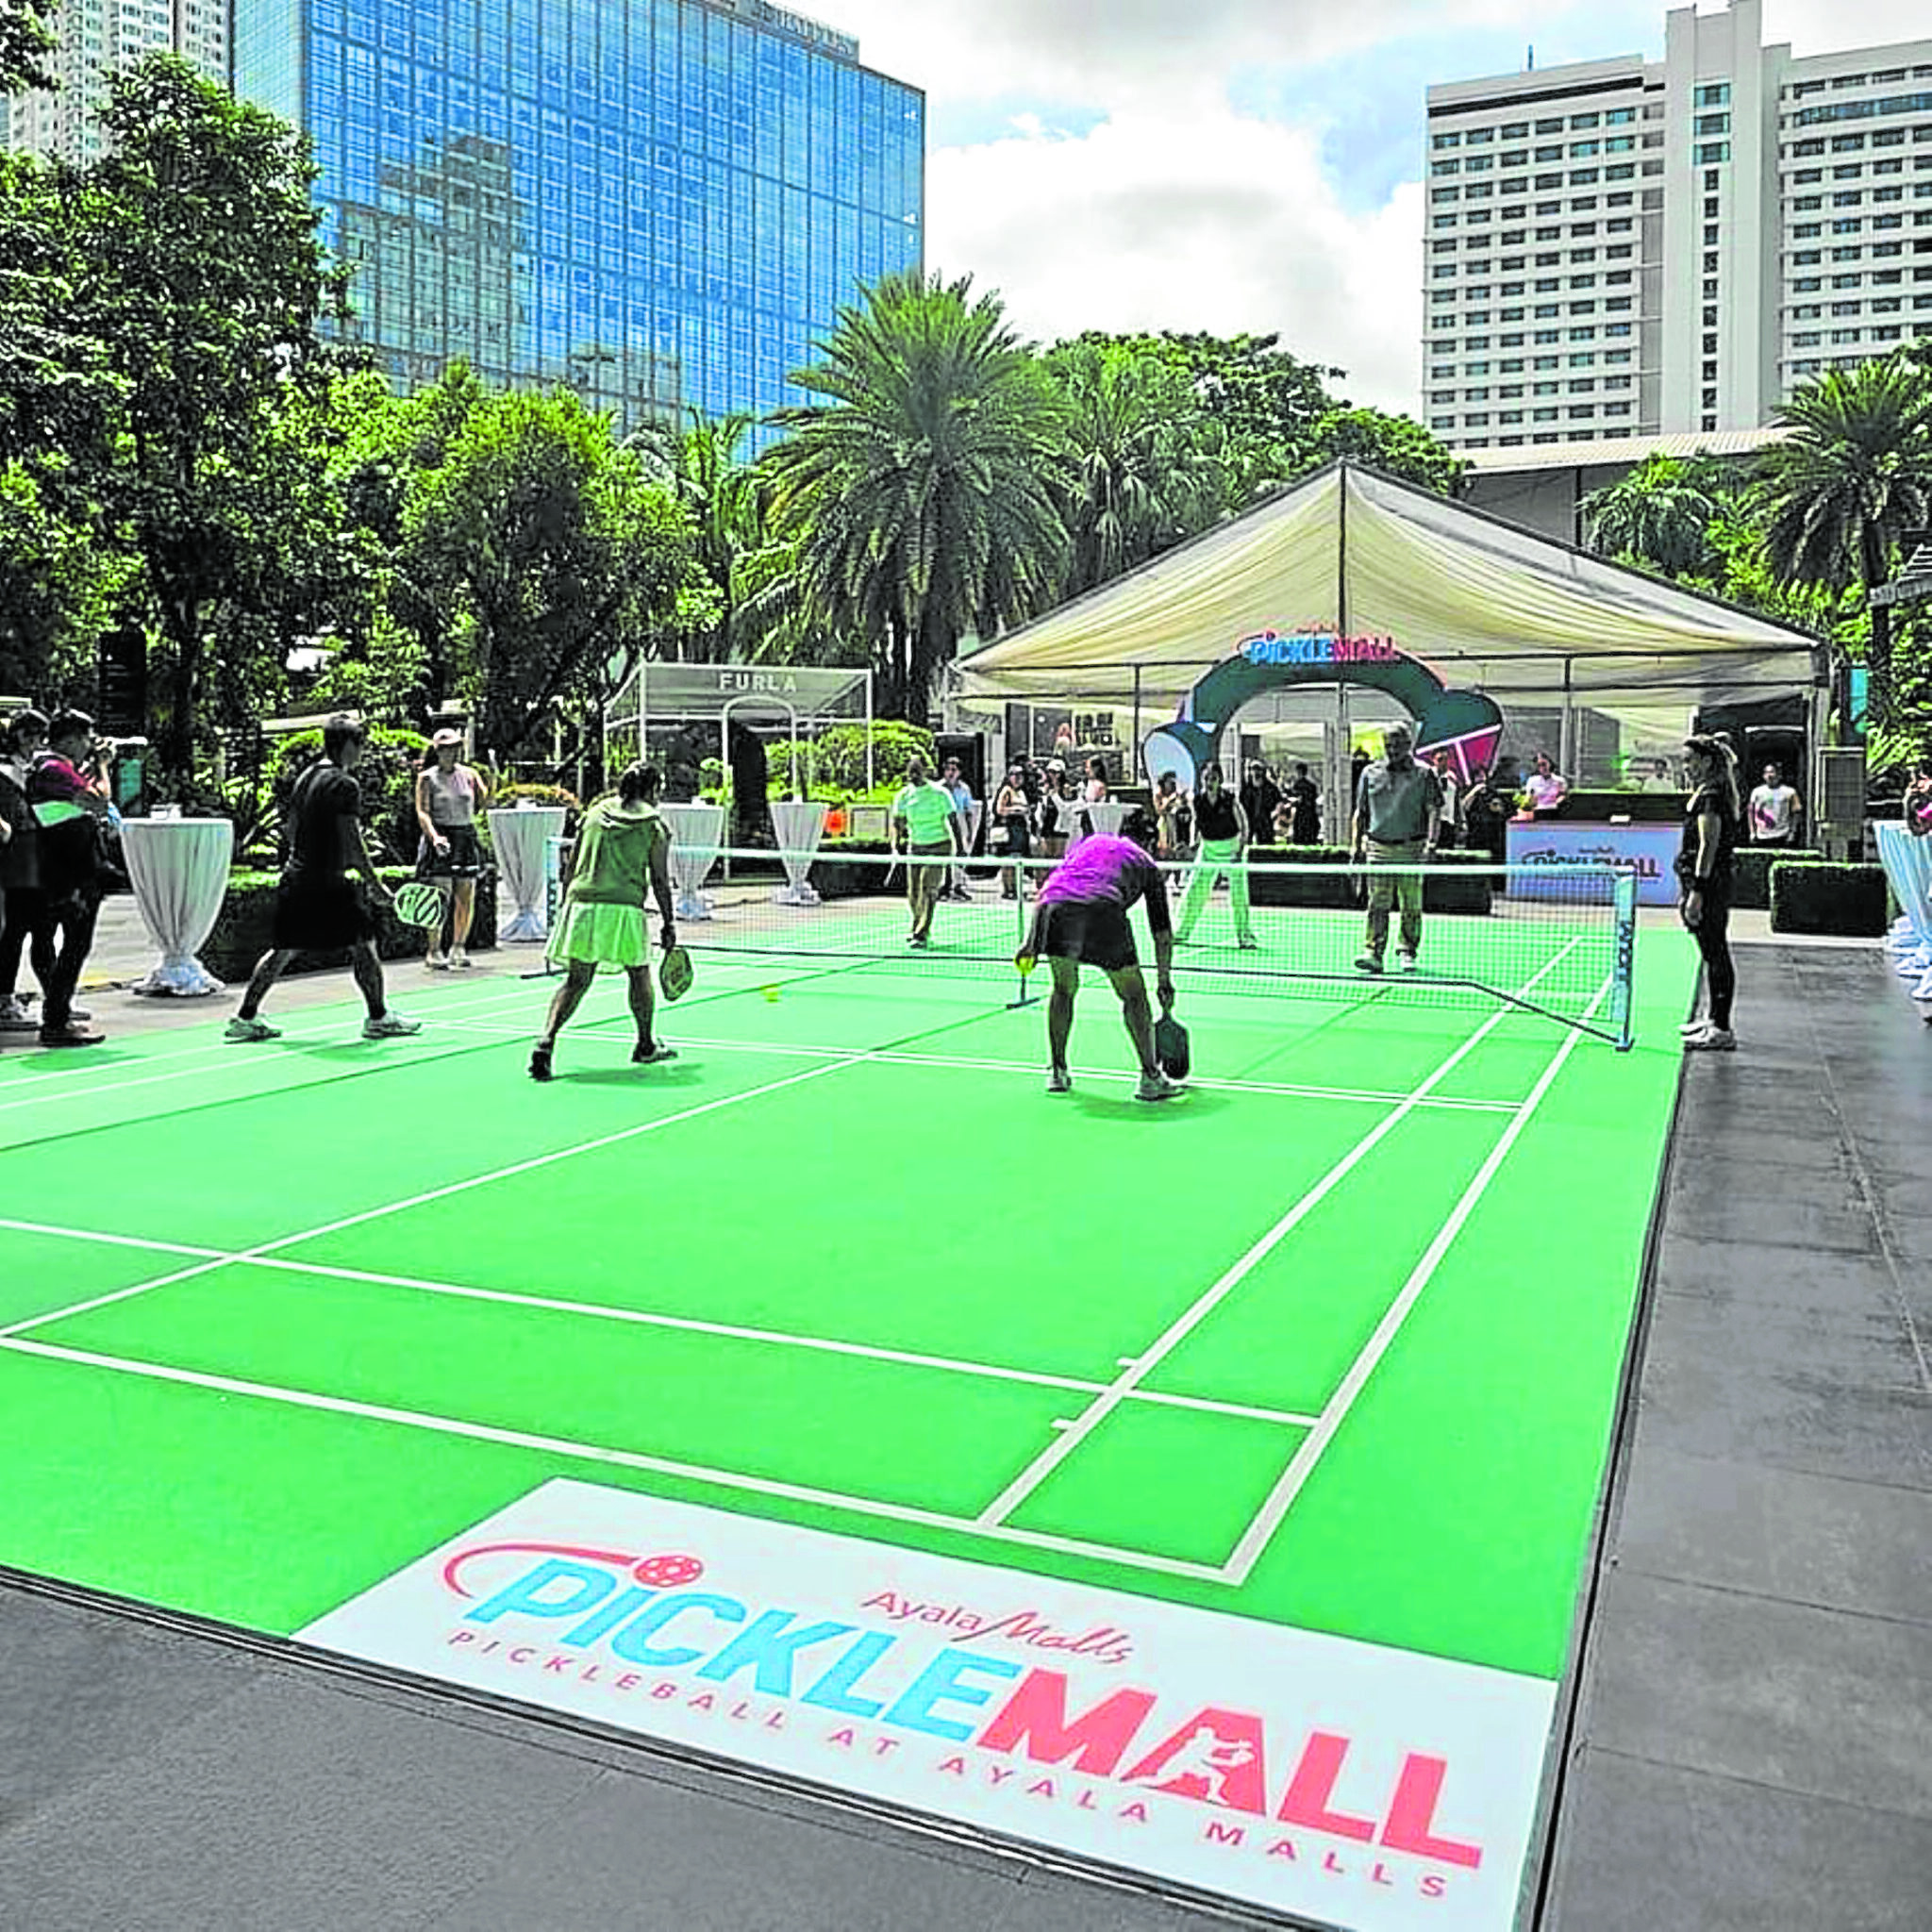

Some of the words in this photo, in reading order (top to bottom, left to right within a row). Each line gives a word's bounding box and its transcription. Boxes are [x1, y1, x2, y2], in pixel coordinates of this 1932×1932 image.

[720, 672, 797, 692] FURLA
[860, 1591, 982, 1632] Ayala
[949, 1609, 1135, 1664] Malls
[447, 1631, 785, 1729] PICKLEBALL
[826, 1728, 901, 1756] AT
[938, 1756, 1147, 1823] AYALA
[1204, 1820, 1447, 1897] MALLS
